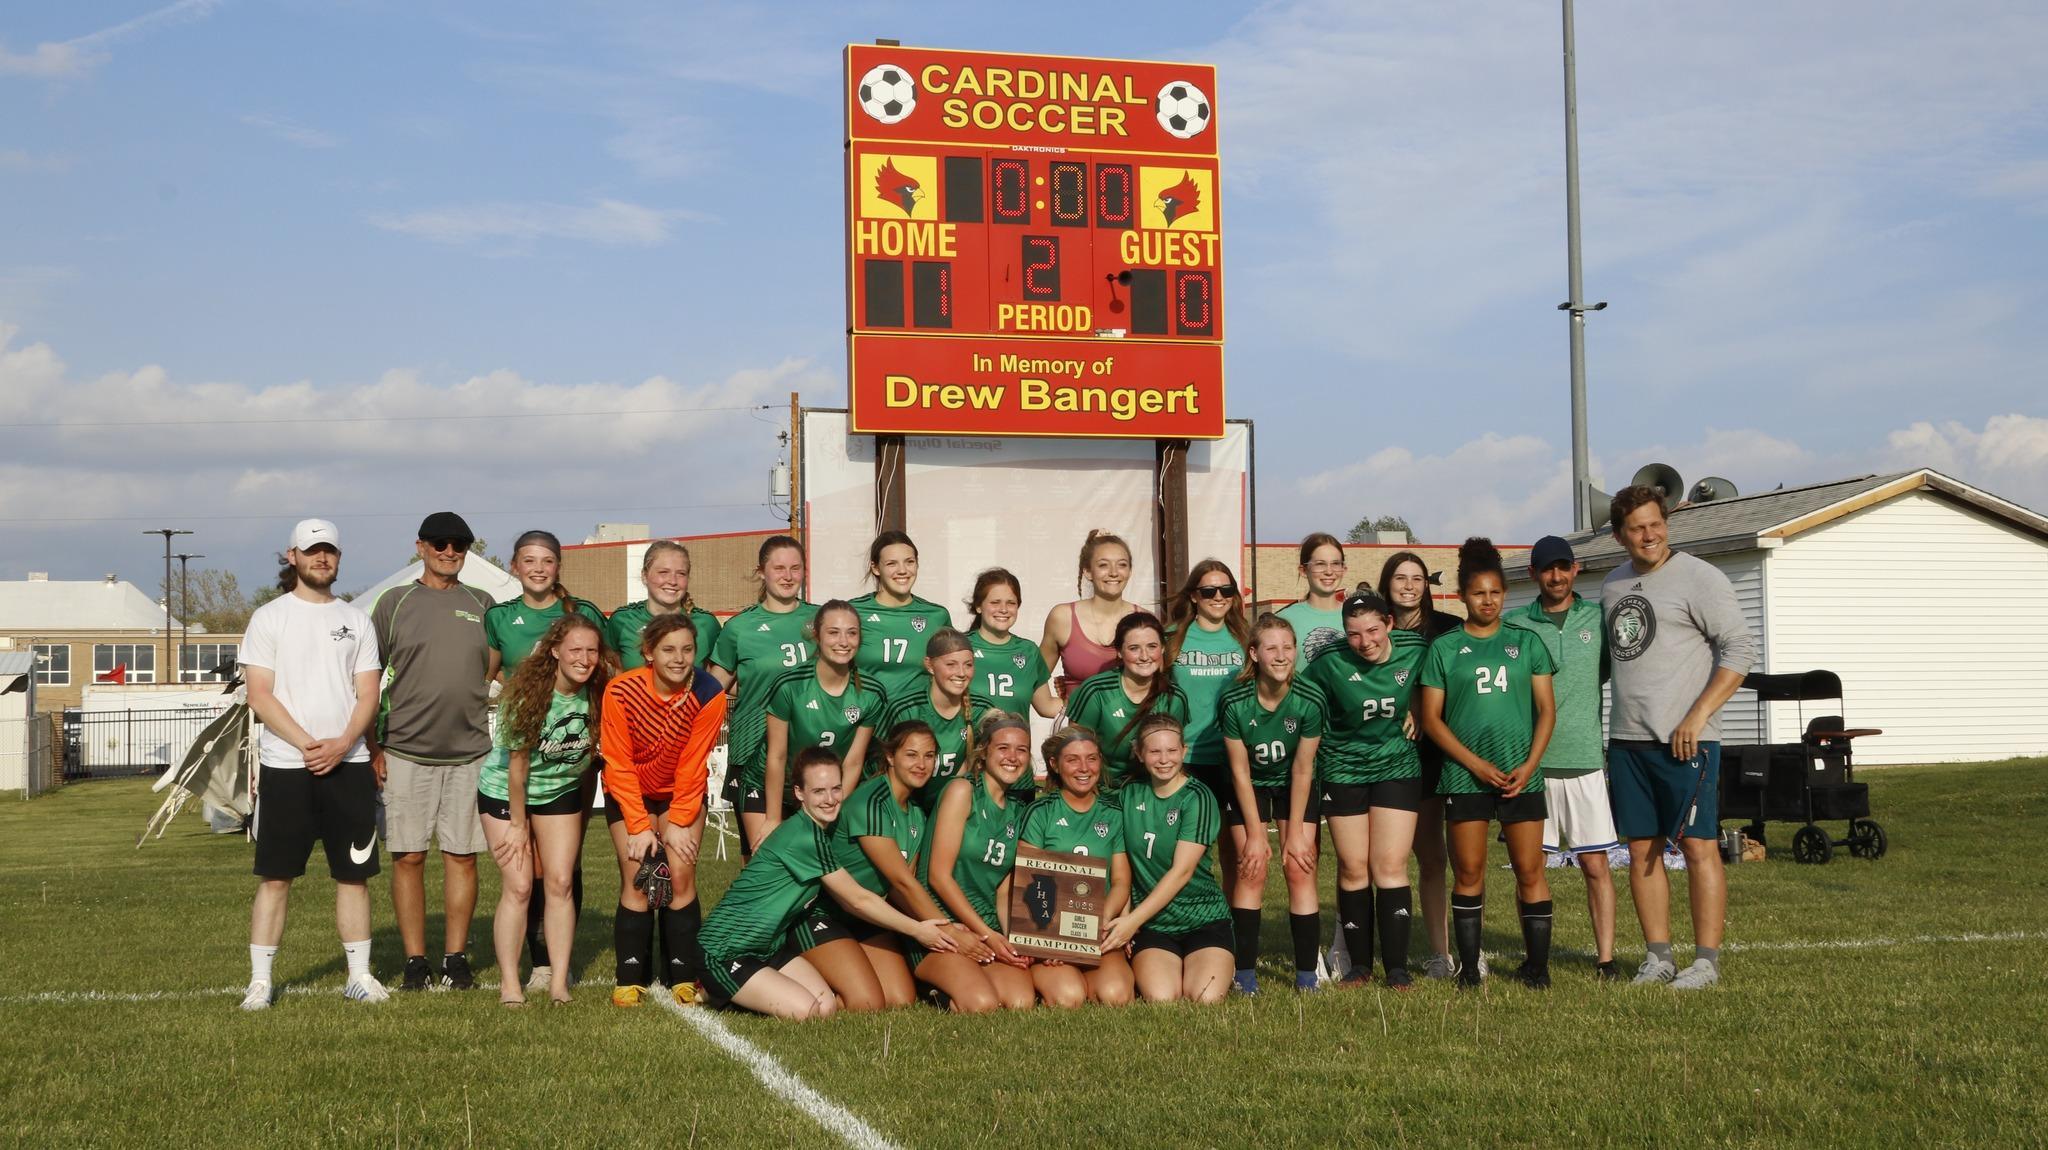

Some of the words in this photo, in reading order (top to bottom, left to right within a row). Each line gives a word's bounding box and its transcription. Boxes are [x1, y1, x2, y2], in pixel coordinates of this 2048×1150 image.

[920, 63, 1149, 107] CARDINAL
[941, 98, 1129, 137] SOCCER
[1012, 145, 1066, 154] DAKTRONICS
[995, 161, 1129, 222] 0:00
[856, 220, 957, 257] HOME
[1120, 230, 1219, 267] GUEST
[1026, 238, 1056, 294] 2
[939, 268, 949, 317] 1
[1179, 274, 1209, 328] 0
[998, 303, 1092, 332] PERIOD
[972, 353, 994, 373] In
[1000, 354, 1086, 379] Memory
[1091, 356, 1115, 376] of
[885, 375, 1006, 409] Drew
[1019, 378, 1200, 421] Bangert
[1617, 599, 1647, 610] ATHENS
[780, 642, 808, 668] 31
[883, 638, 908, 664] 17
[988, 673, 1014, 697] 12
[1190, 667, 1230, 676] warriors
[1475, 665, 1509, 695] 24
[1362, 697, 1396, 722] 25
[932, 752, 957, 778] 15
[1254, 740, 1287, 766] 20
[983, 838, 1006, 867] 13
[1143, 832, 1156, 860] 7
[1026, 859, 1096, 876] REGIONAL
[1071, 922, 1087, 930] SOCCER
[1014, 935, 1097, 954] CHAMPIONS
